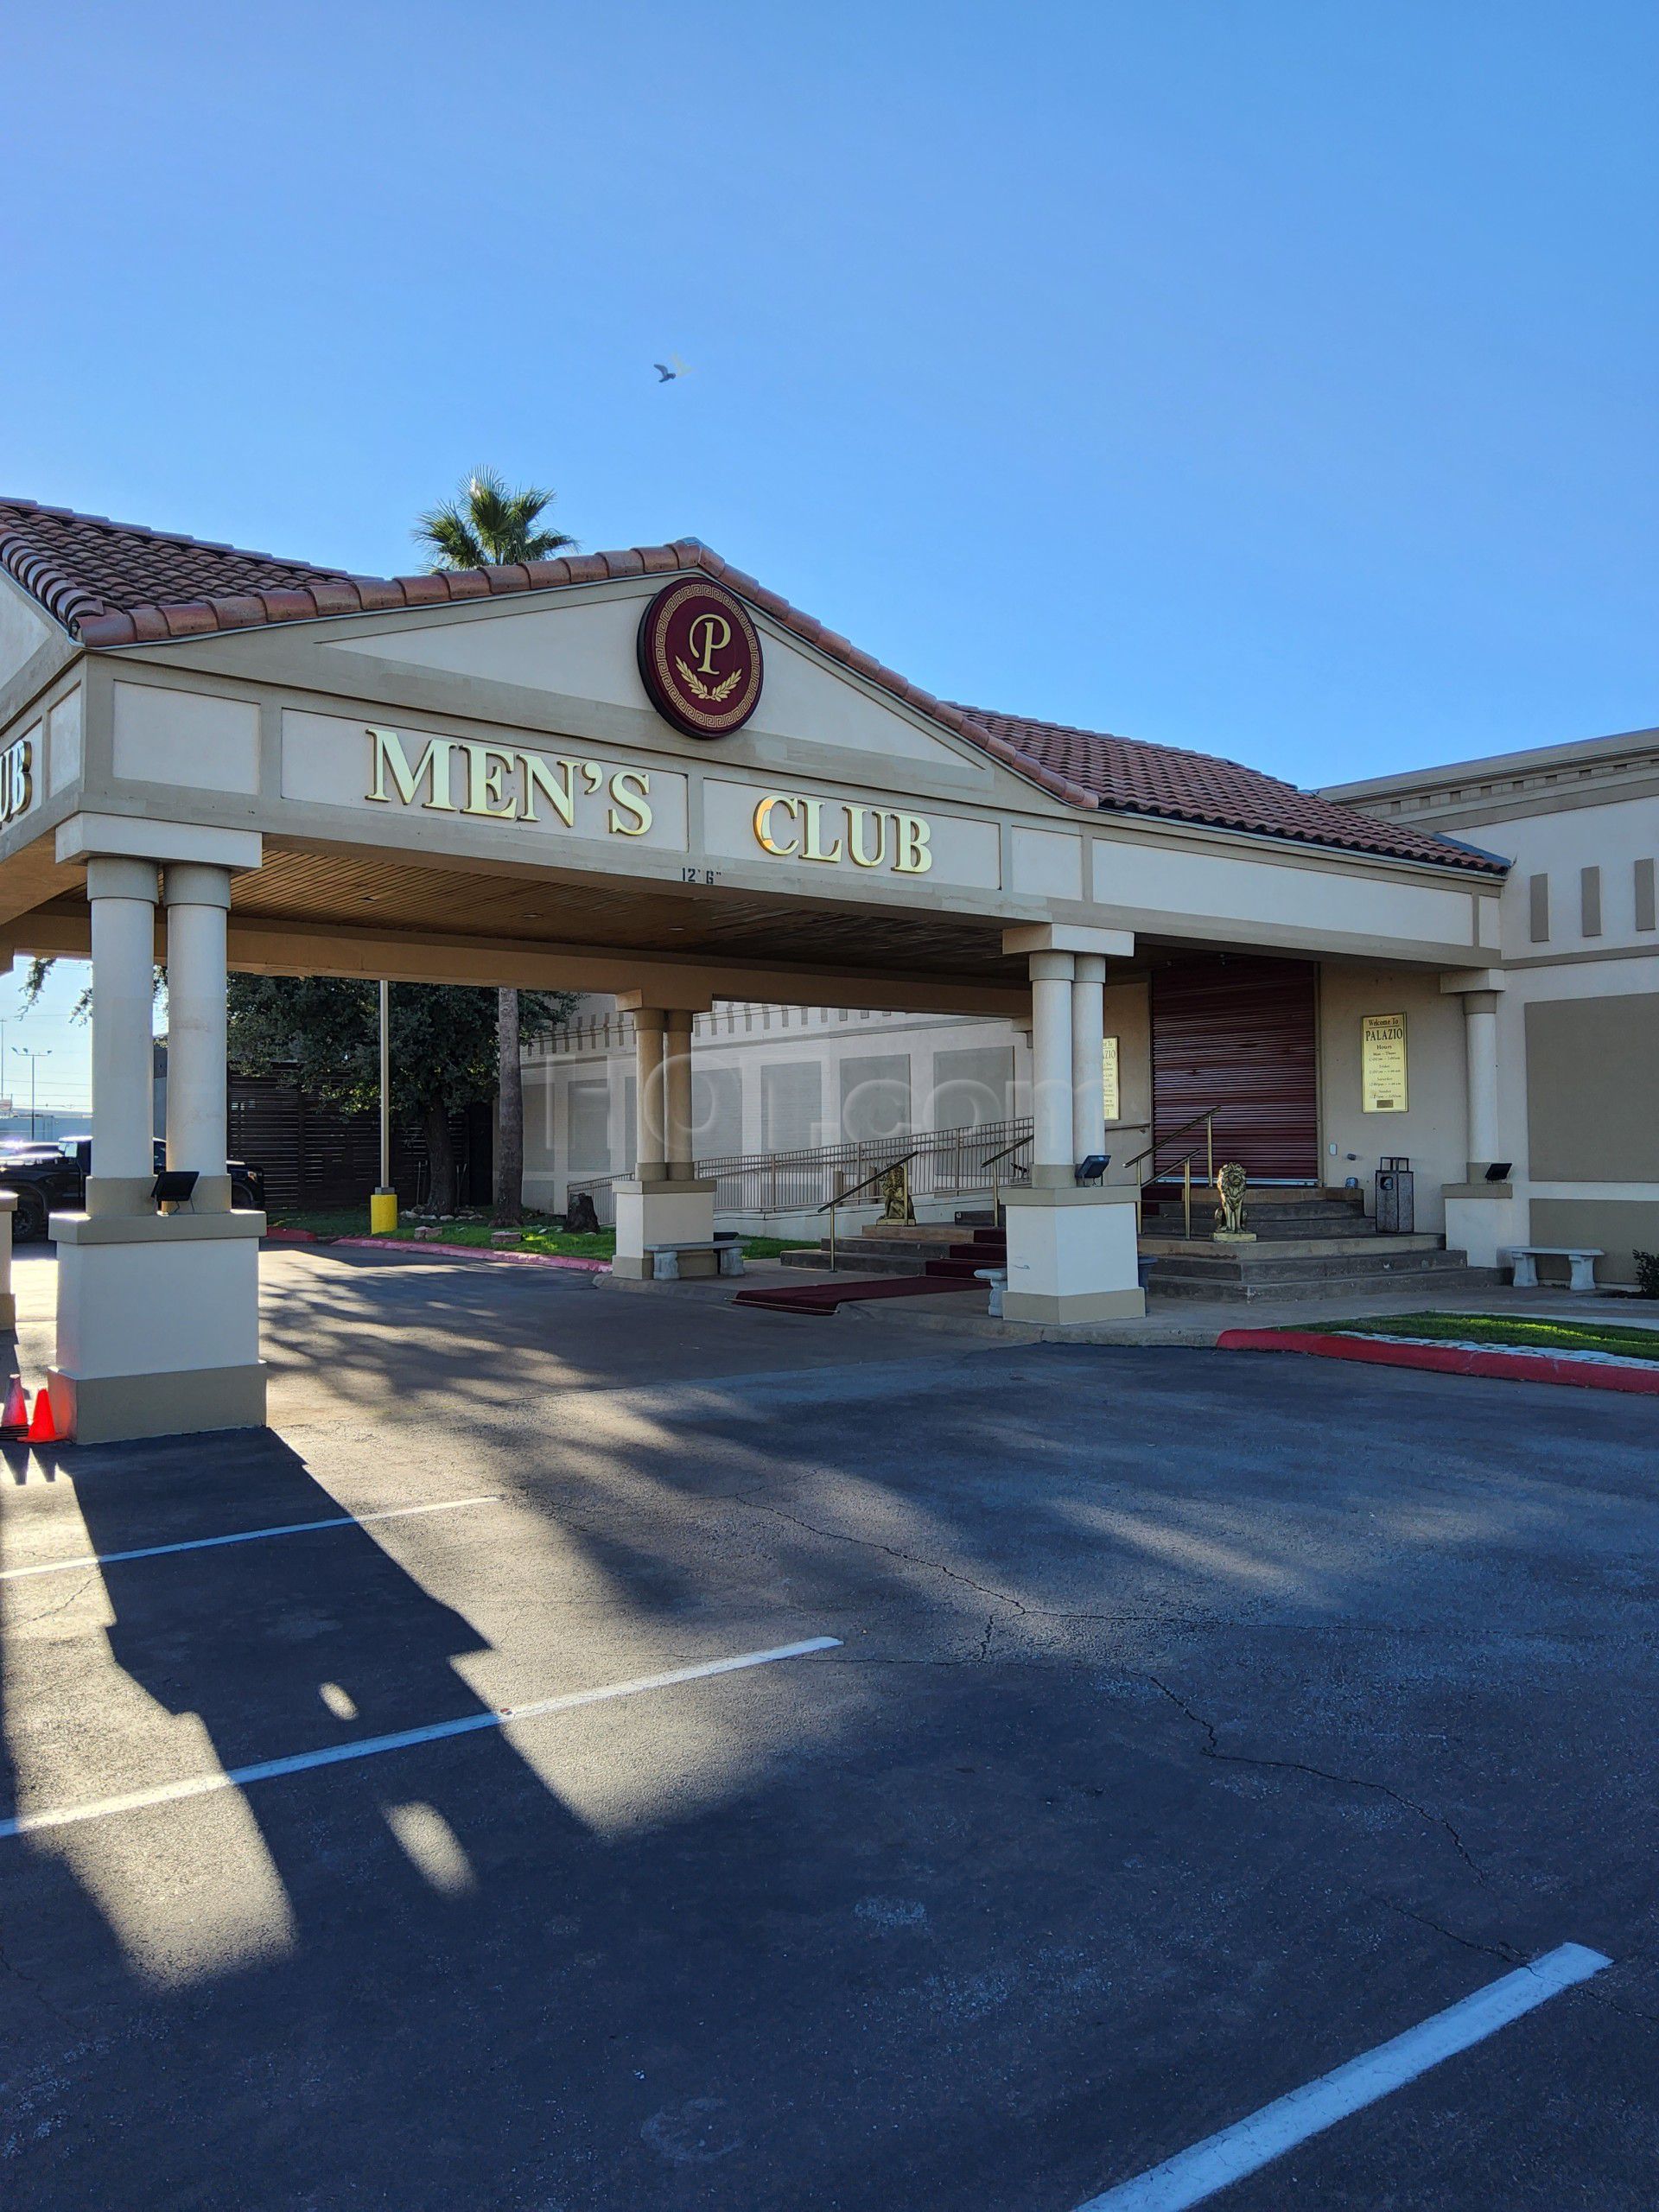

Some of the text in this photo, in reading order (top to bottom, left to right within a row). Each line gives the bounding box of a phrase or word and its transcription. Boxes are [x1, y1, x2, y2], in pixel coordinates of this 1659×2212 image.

[690, 613, 731, 675] P
[753, 795, 932, 873] CLUB
[1366, 1028, 1402, 1041] PALAZIO
